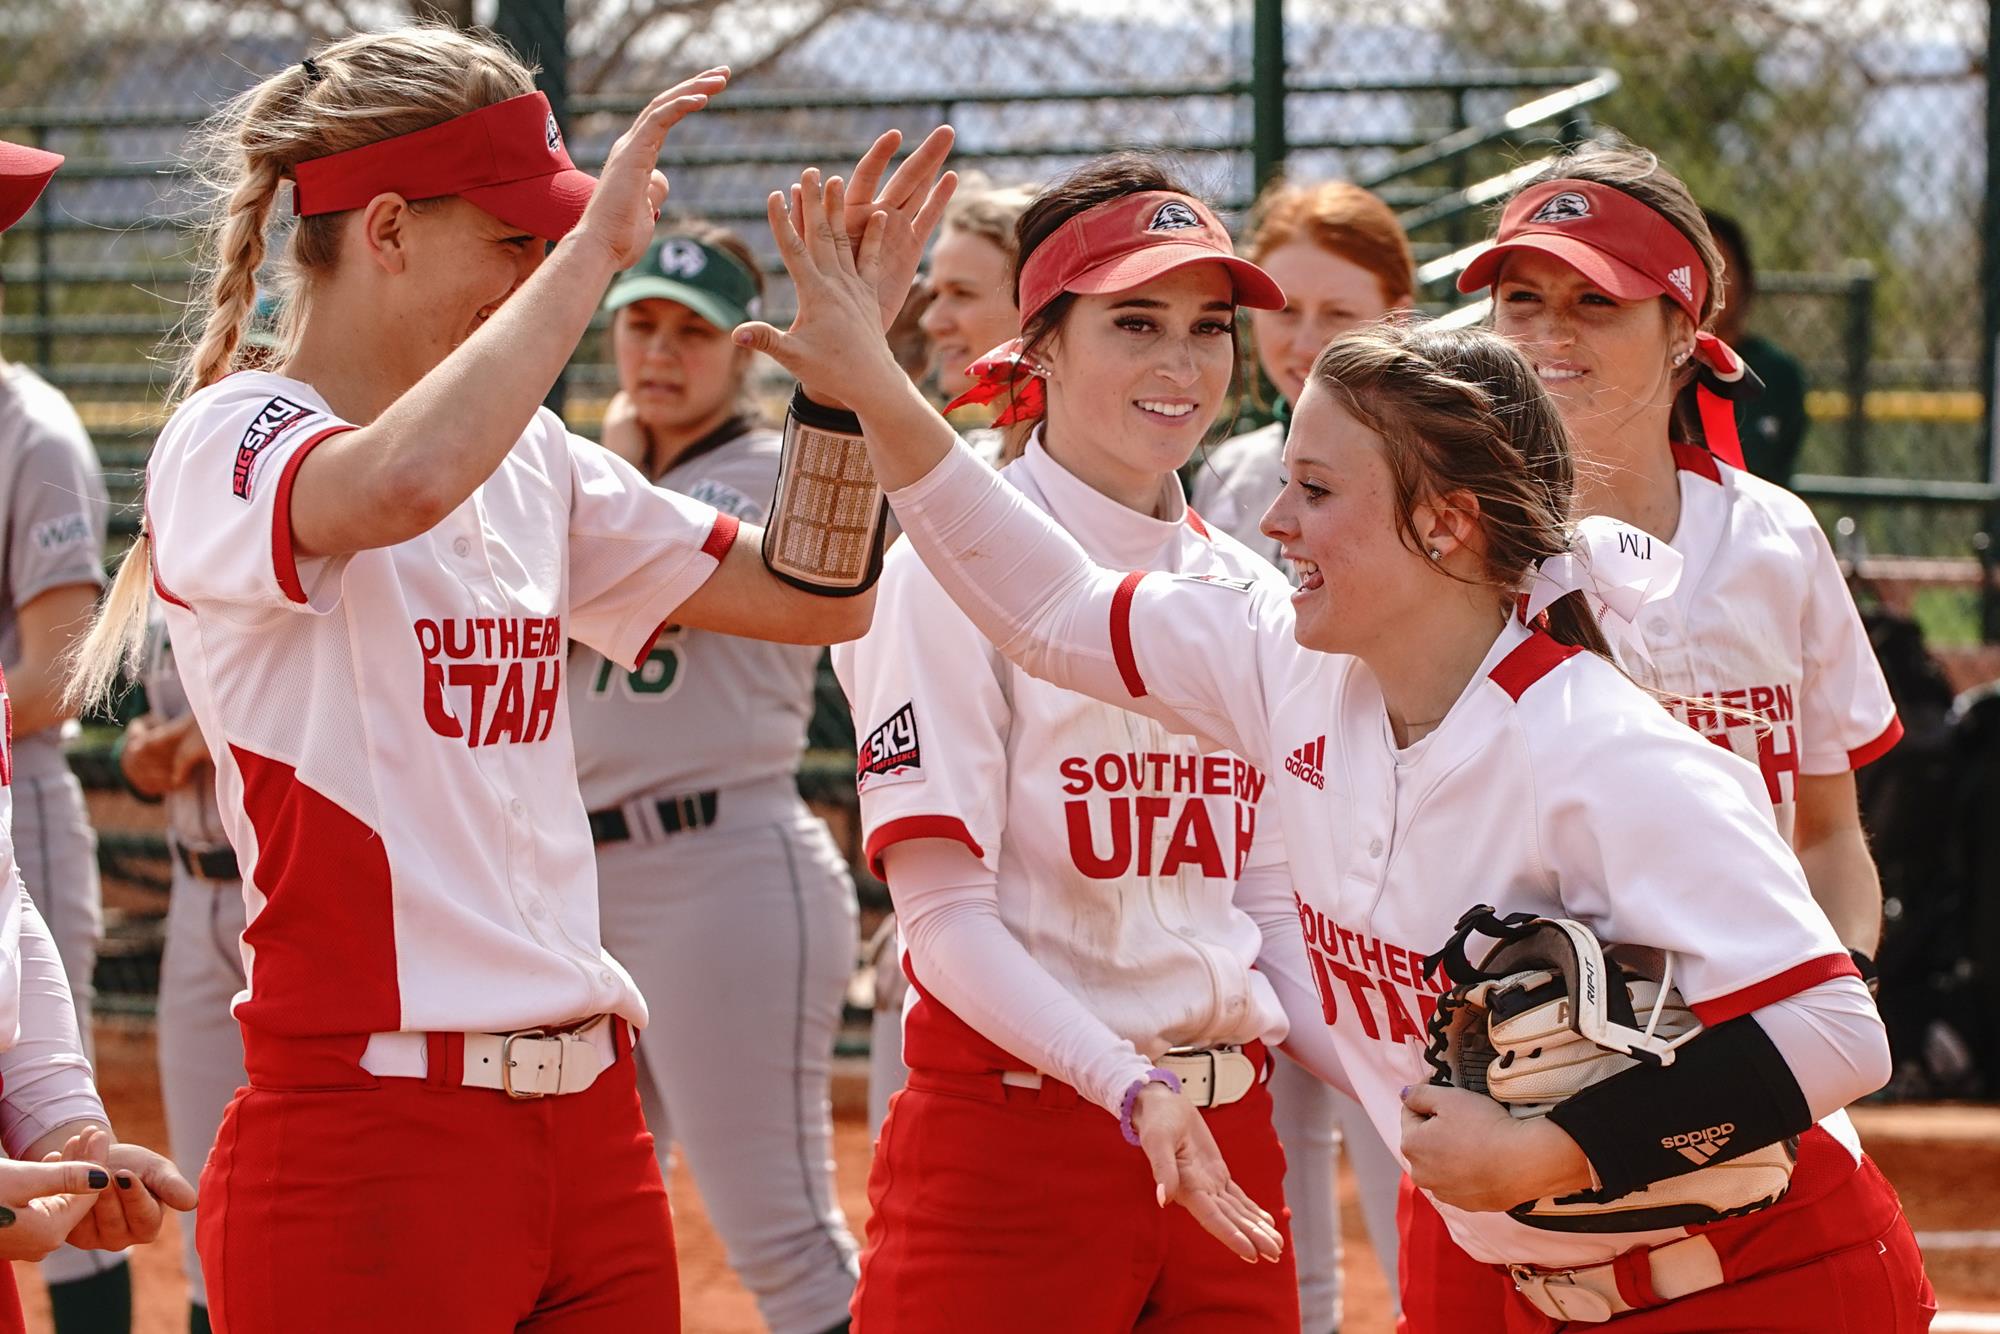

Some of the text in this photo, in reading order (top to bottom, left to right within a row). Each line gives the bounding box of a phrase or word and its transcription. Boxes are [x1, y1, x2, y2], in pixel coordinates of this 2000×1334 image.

[1617, 531, 1652, 560] I'M
[413, 615, 560, 659] OUTHERN
[423, 659, 560, 748] UTAH
[1059, 752, 1266, 804] SOUTHERN
[1285, 756, 1325, 790] adidas
[1064, 796, 1256, 881] UTAH
[1295, 890, 1453, 995] OUTHER
[1661, 1122, 1736, 1149] adidas
